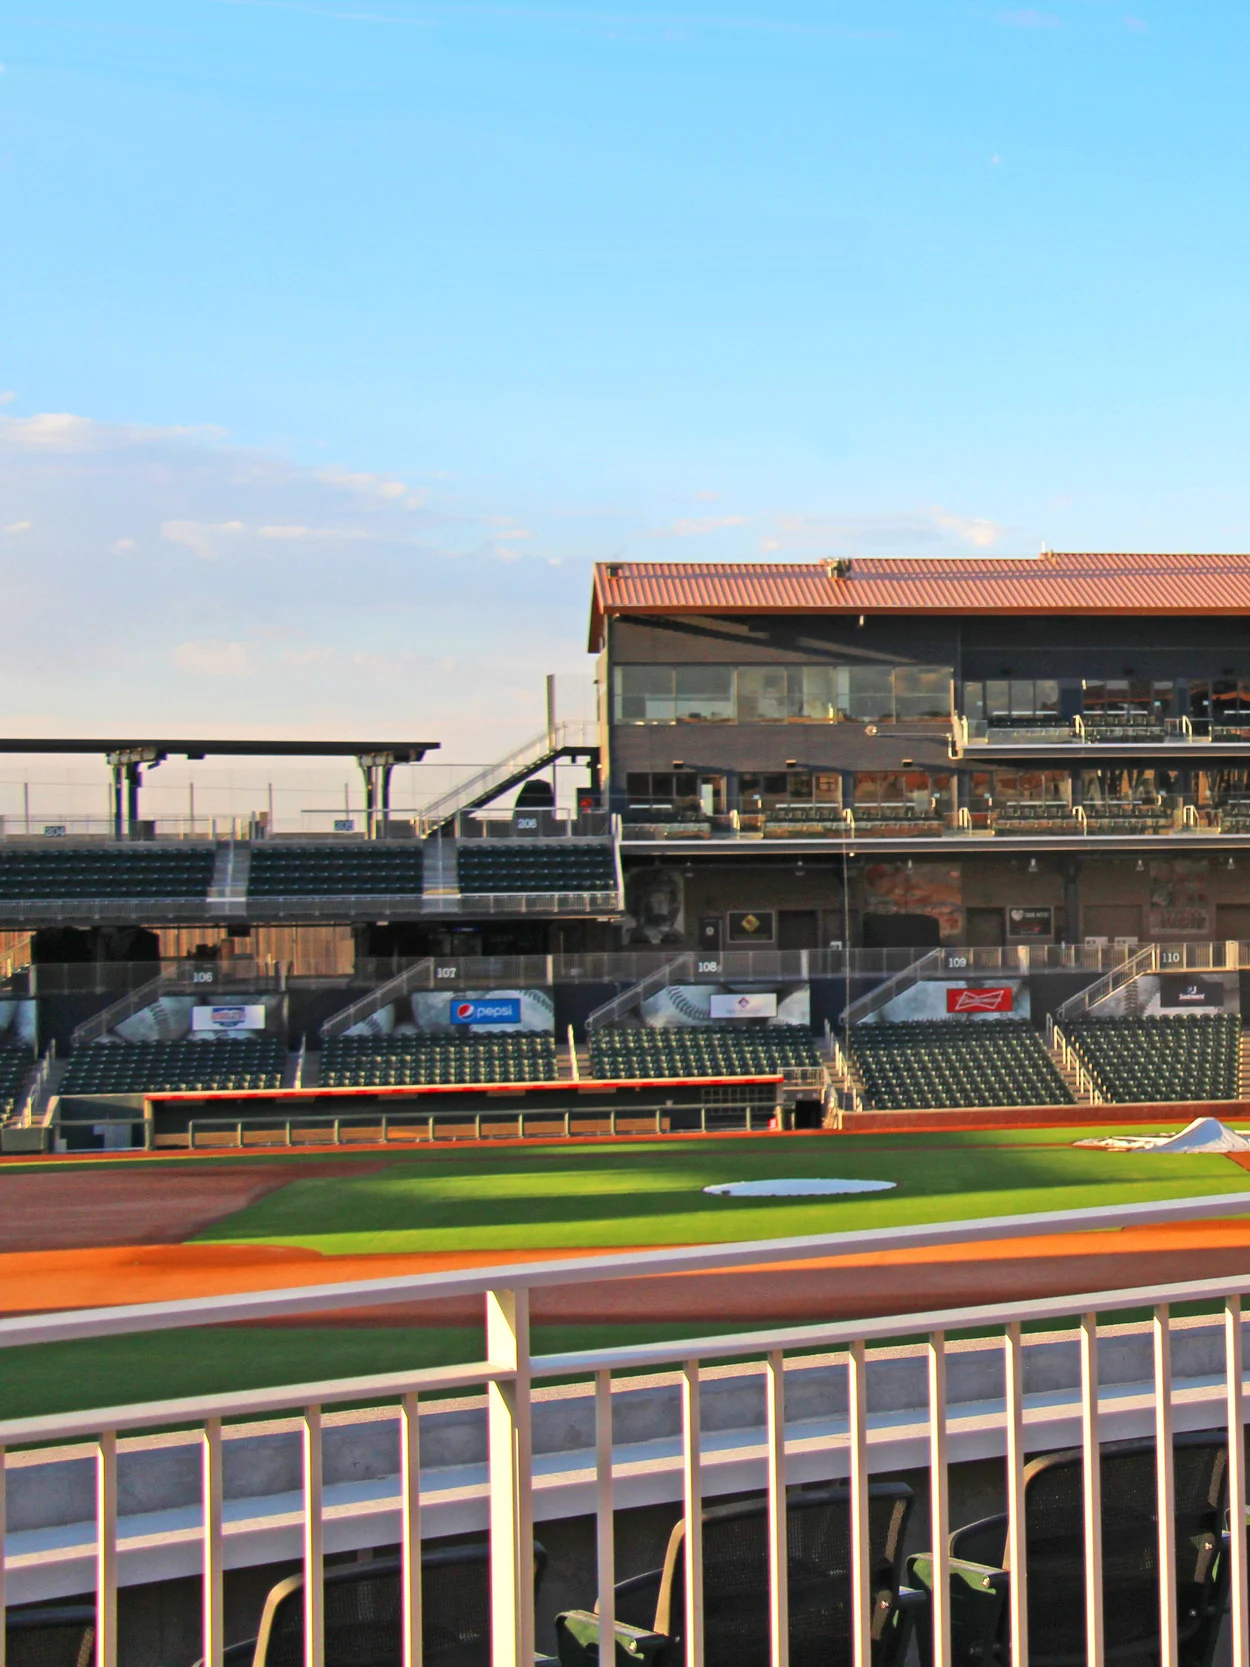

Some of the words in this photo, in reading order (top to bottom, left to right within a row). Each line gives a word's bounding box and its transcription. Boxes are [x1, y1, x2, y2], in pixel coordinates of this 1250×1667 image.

[948, 957, 967, 968] 109
[1162, 952, 1180, 963] 110
[437, 967, 457, 979] 107
[698, 961, 717, 973] 108
[193, 971, 213, 983] 106
[476, 1004, 512, 1018] pepsi
